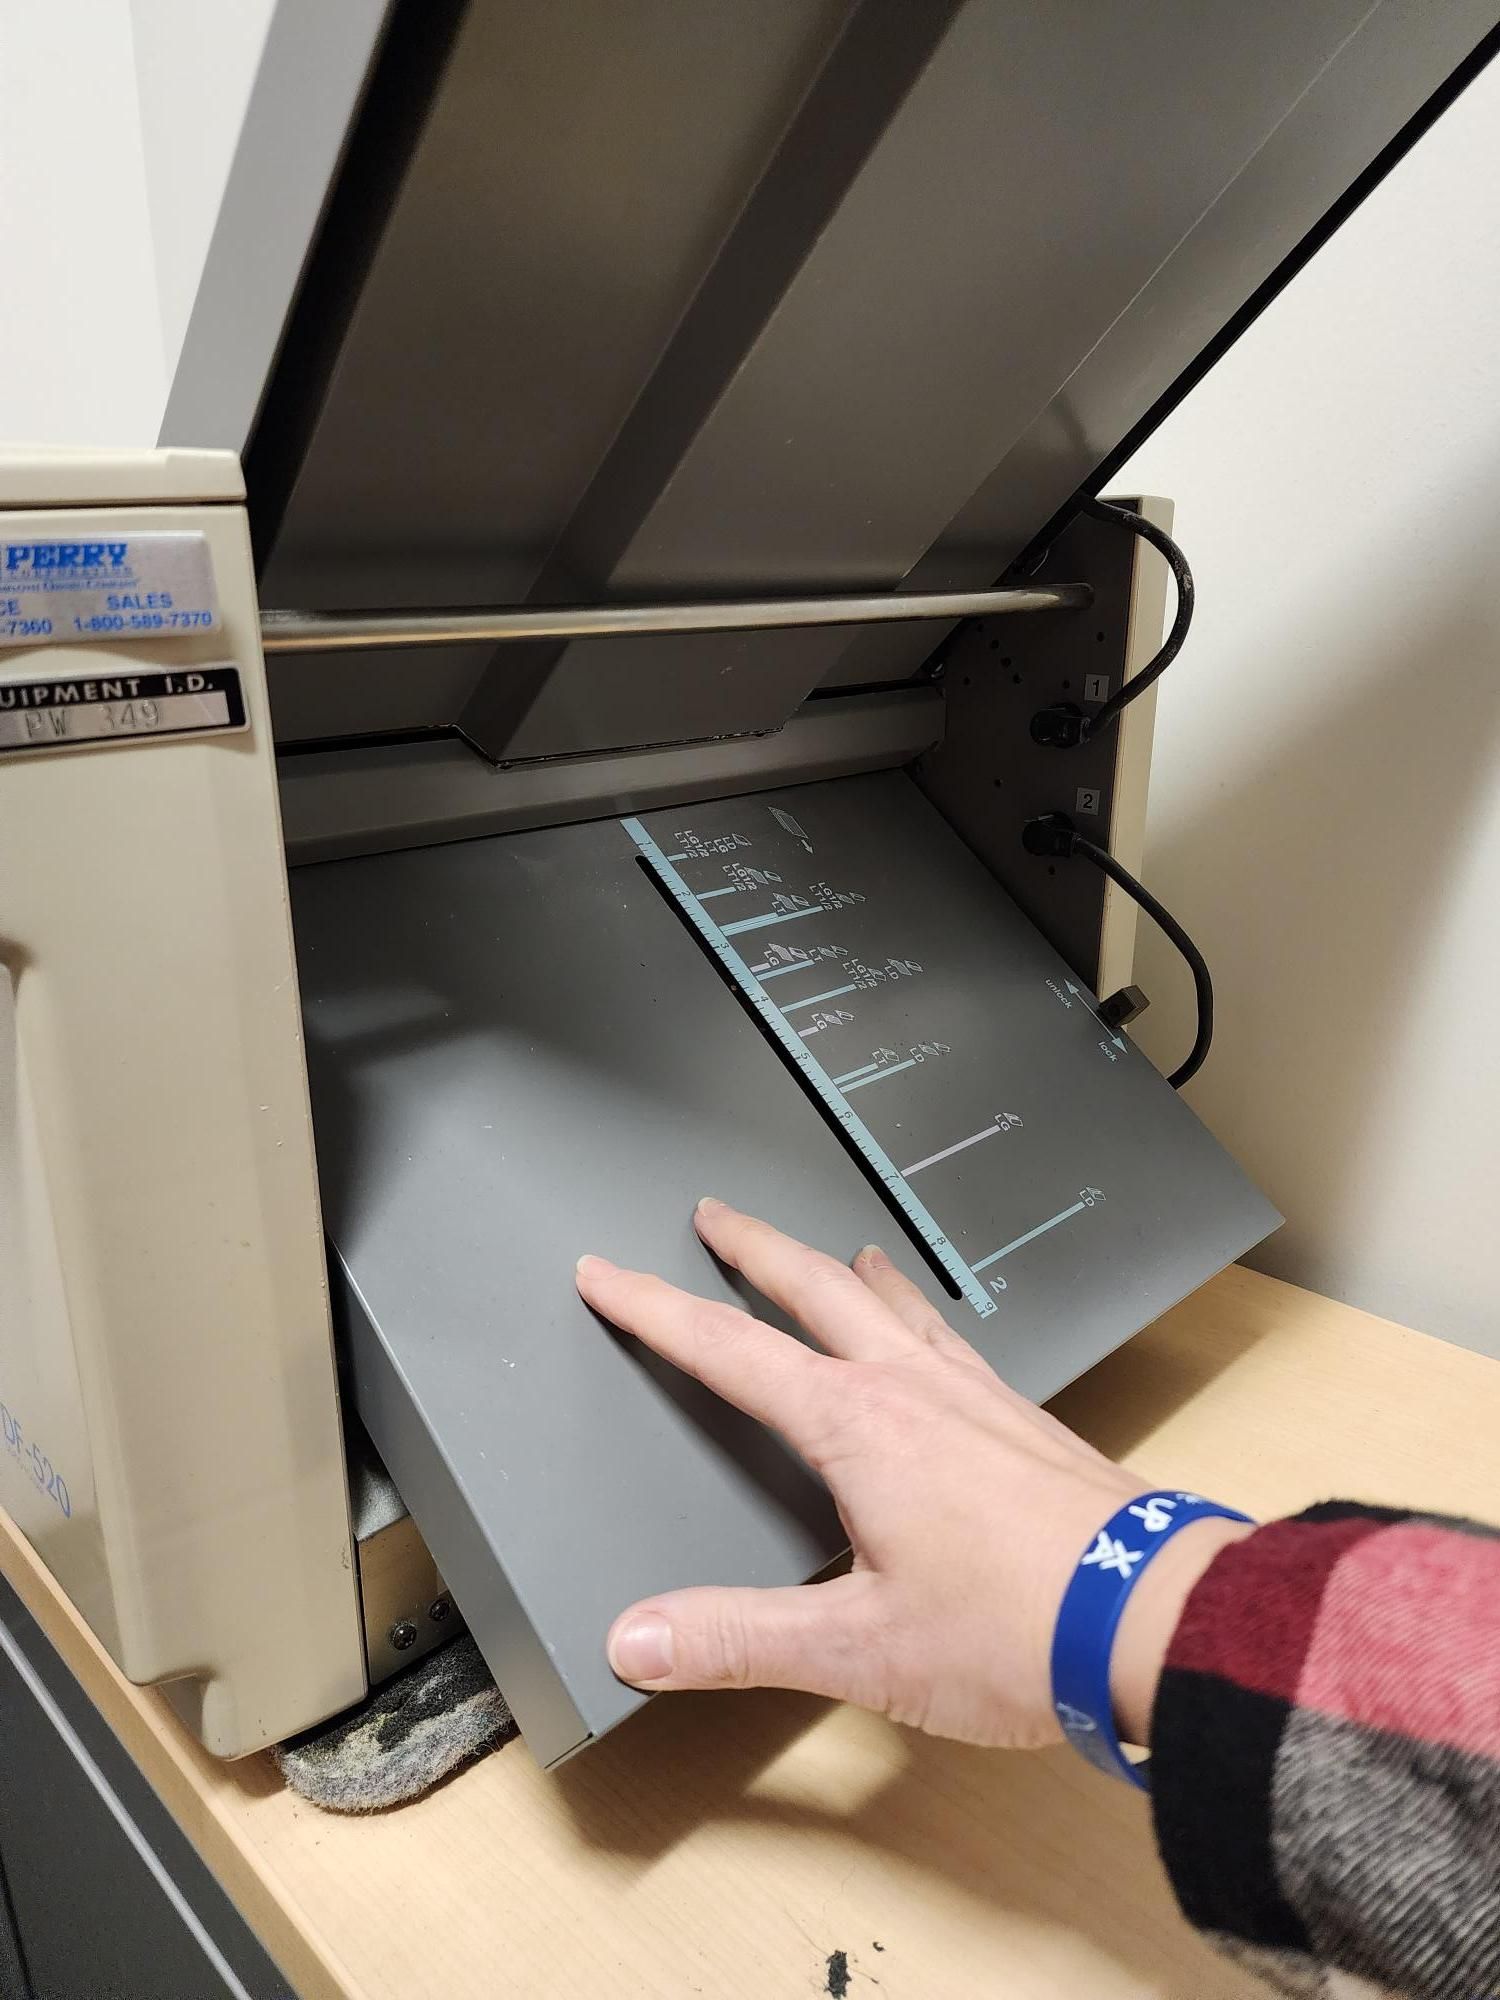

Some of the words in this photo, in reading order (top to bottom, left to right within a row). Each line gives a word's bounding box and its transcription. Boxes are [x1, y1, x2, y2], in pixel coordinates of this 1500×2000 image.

[6, 543, 127, 570] PERRY
[106, 592, 174, 611] SALES
[165, 674, 214, 694] I.D.
[1092, 679, 1100, 697] 1
[24, 708, 67, 738] PW
[1083, 793, 1093, 809] 2
[714, 839, 728, 853] LG
[722, 837, 737, 849] LD
[809, 885, 833, 910] LT1/2
[818, 882, 843, 909] LG1/2
[771, 901, 787, 913] LT
[763, 950, 780, 966] LG
[808, 949, 824, 961] LT
[842, 962, 867, 990] LT1/2
[851, 959, 877, 987] LG1/2
[884, 965, 899, 979] LD
[1045, 979, 1072, 1009] unlock
[811, 1013, 827, 1029] LG
[872, 1050, 888, 1064] LT
[909, 1047, 925, 1063] LD
[1098, 1041, 1118, 1062] lock
[994, 1113, 1011, 1132] LG
[889, 1172, 900, 1180] 7
[1079, 1189, 1095, 1207] LD
[936, 1236, 946, 1245] 8
[990, 1276, 1008, 1294] 2
[984, 1301, 994, 1311] 9
